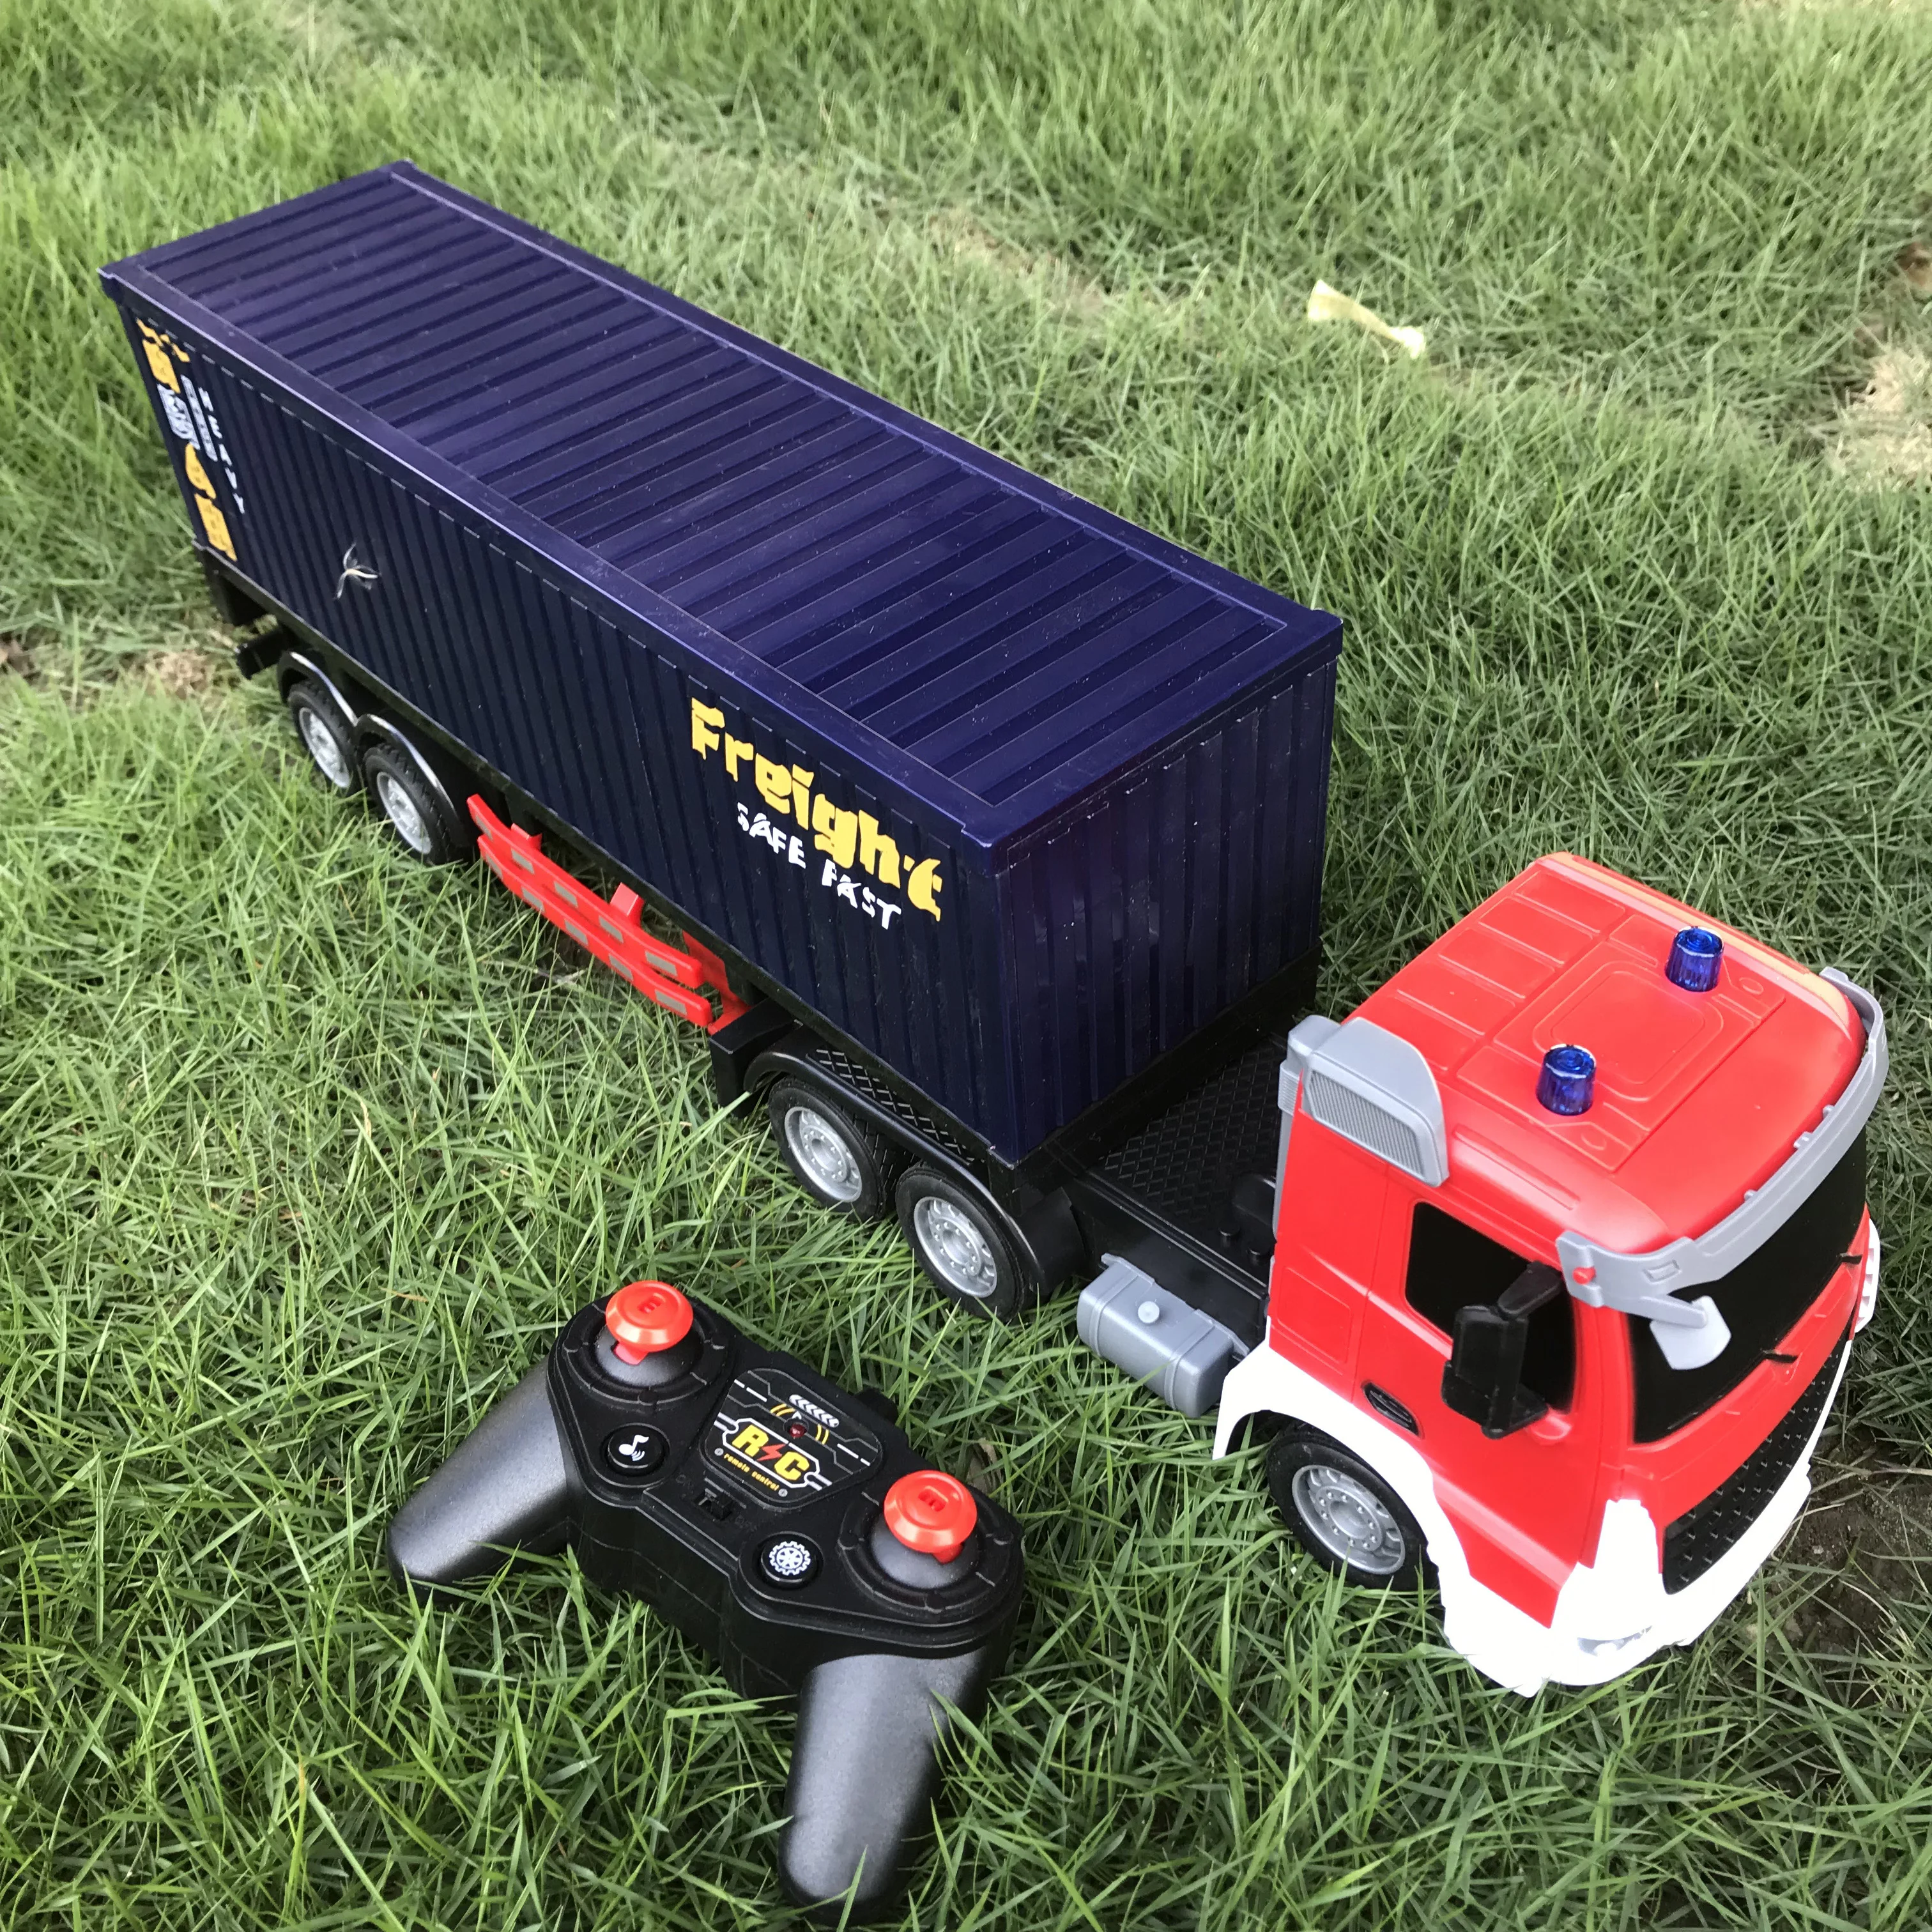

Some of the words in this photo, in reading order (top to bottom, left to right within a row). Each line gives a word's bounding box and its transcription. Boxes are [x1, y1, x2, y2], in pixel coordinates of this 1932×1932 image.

[691, 697, 942, 922] Freight
[737, 802, 806, 869] SAFE
[822, 859, 901, 930] FAST
[723, 1453, 750, 1473] remote
[751, 1471, 779, 1491] control
